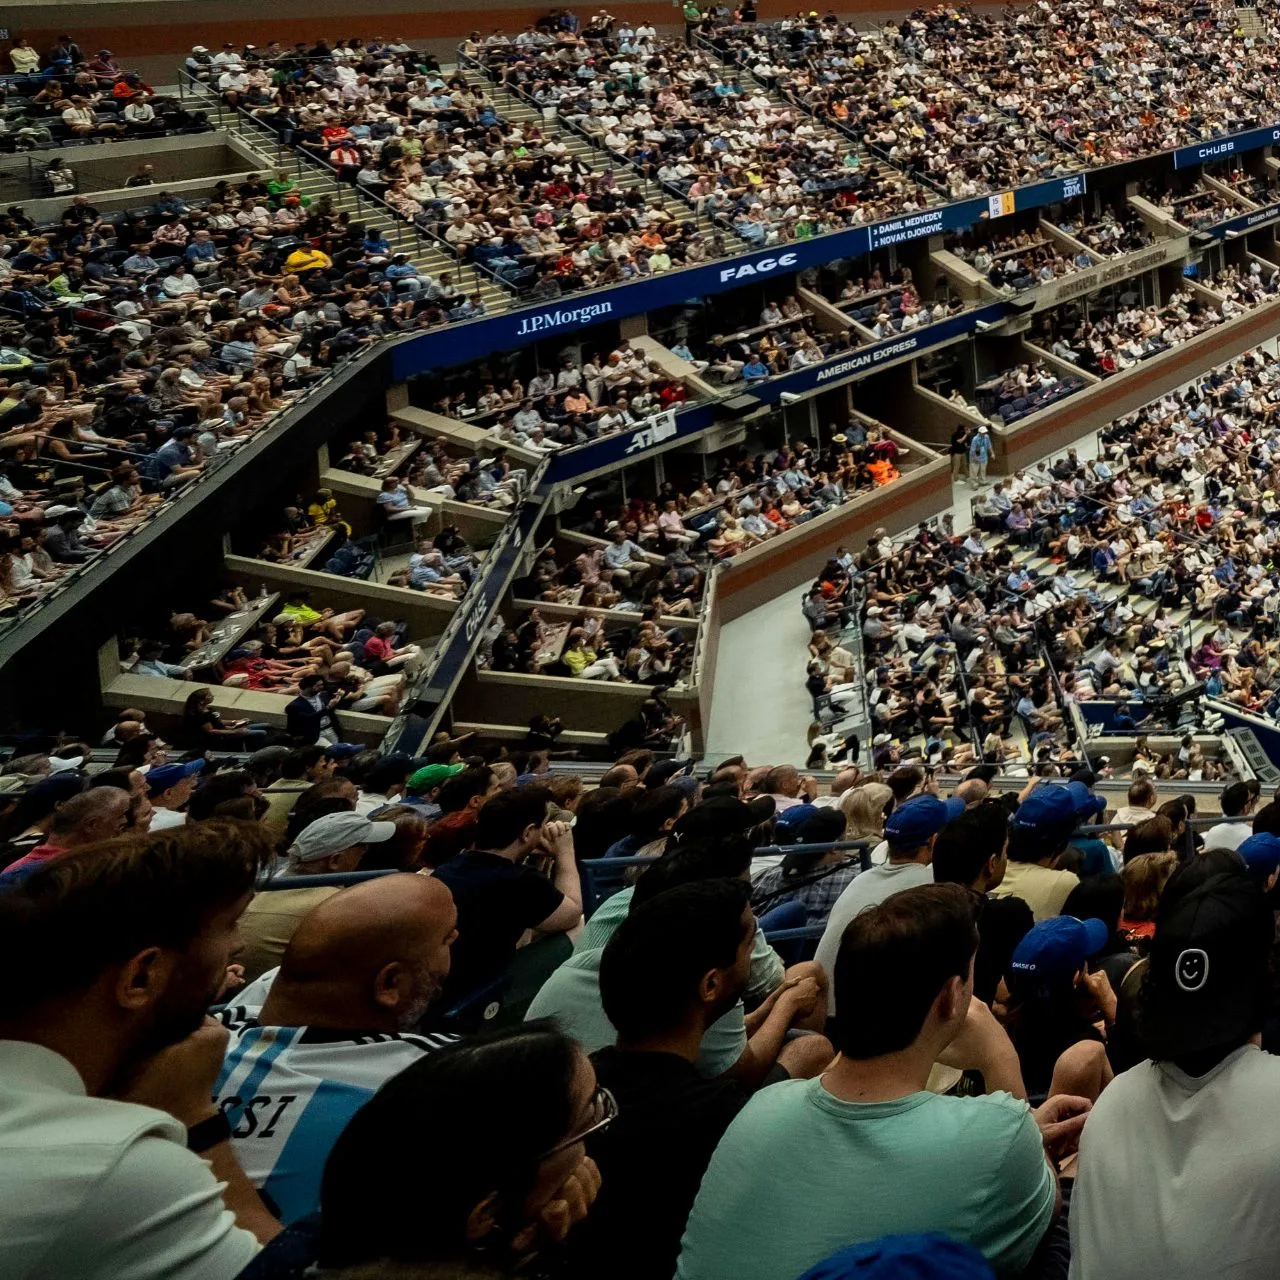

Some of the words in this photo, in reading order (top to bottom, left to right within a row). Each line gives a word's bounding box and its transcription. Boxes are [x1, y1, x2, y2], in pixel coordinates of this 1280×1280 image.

[1199, 142, 1235, 158] CHUBB
[1063, 183, 1081, 198] IBM
[879, 220, 904, 234] DANIIL
[904, 211, 943, 229] MEDVEDEV
[993, 208, 1000, 216] 15
[880, 231, 905, 245] NOVAK
[905, 223, 943, 239] DJOKOVIC
[720, 253, 798, 282] FAGE
[517, 301, 612, 336] J.P.Morgan
[816, 354, 872, 381] AMERICAN
[873, 337, 918, 361] EXPRESS
[466, 592, 487, 642] CHASE
